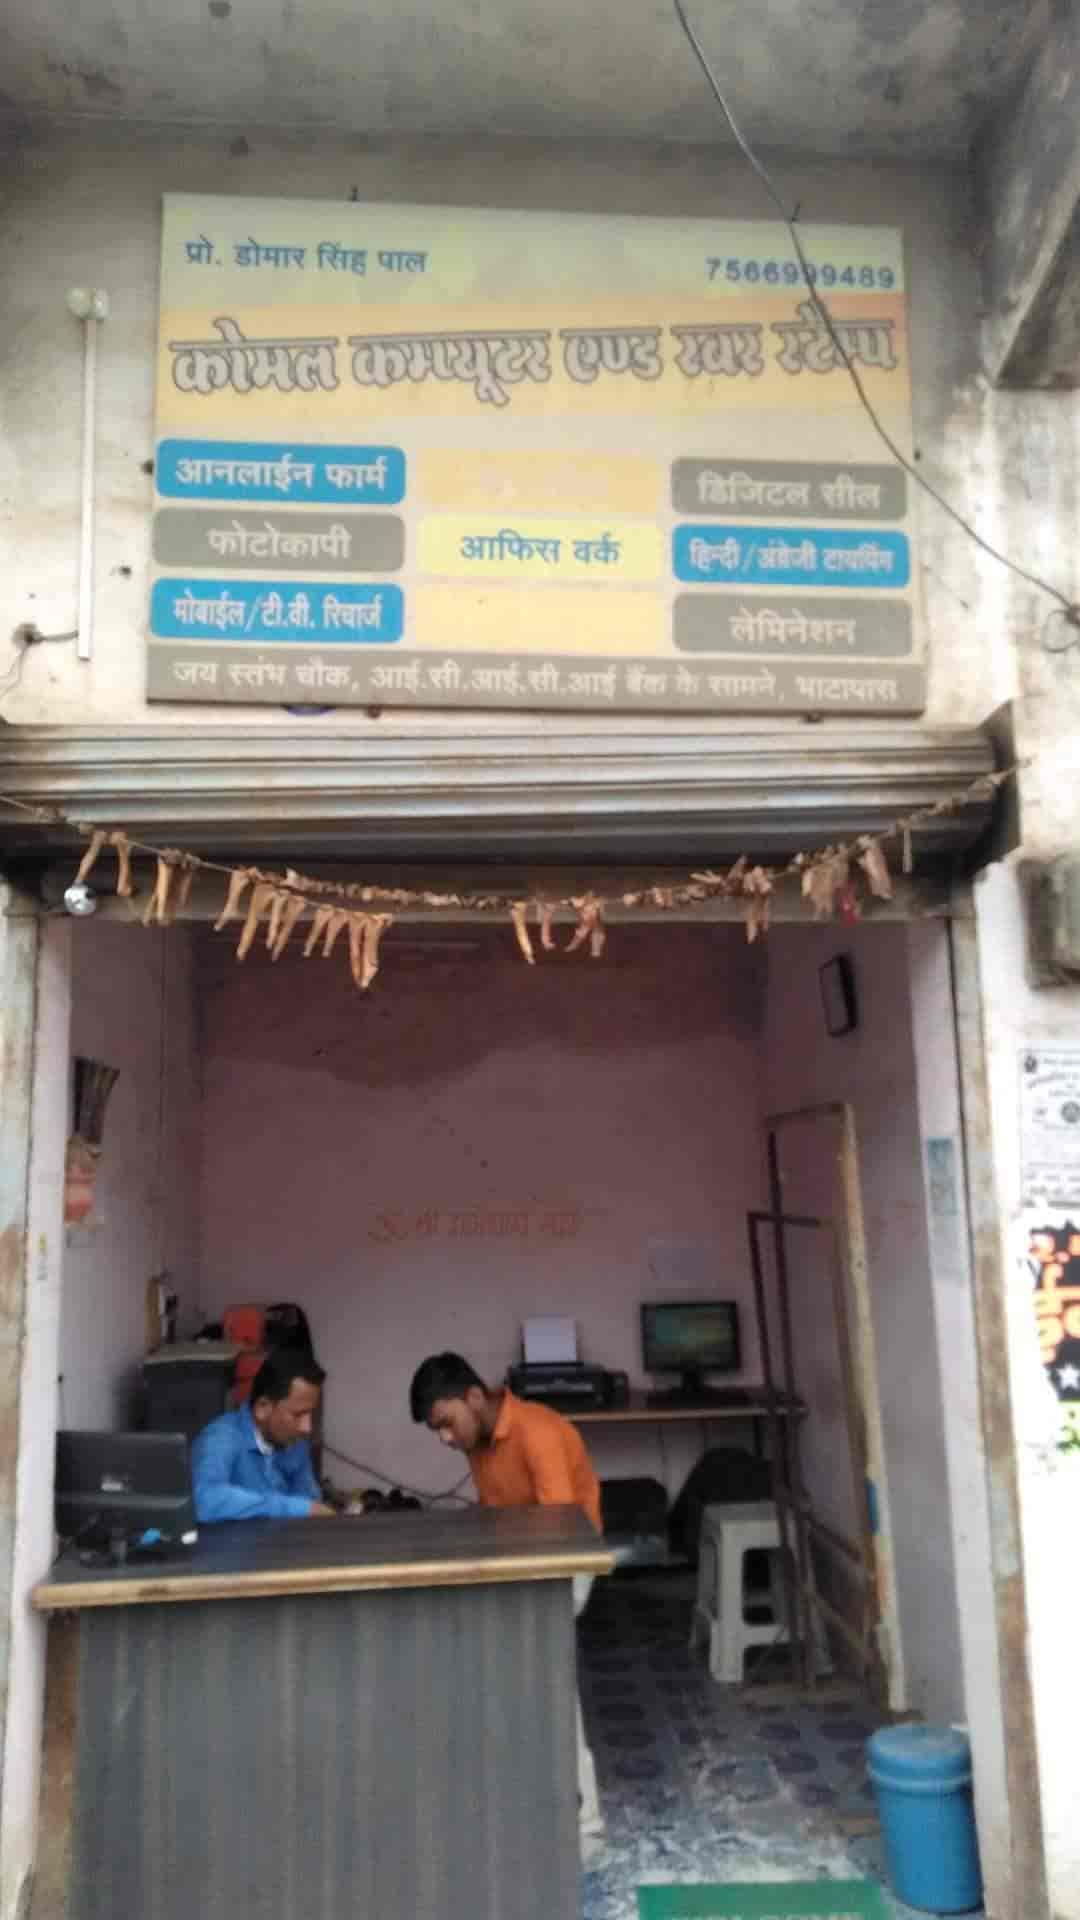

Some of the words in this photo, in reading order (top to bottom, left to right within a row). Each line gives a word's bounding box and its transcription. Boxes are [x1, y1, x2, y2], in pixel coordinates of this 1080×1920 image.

[235, 238, 305, 269] डोमार
[318, 242, 367, 275] सिंह
[378, 250, 427, 273] पाल
[705, 257, 895, 288] 7566999489
[169, 317, 340, 394] कोमल
[559, 326, 664, 384] एण्ड
[175, 455, 314, 491] आनलाईन
[326, 456, 388, 490] फार्म
[697, 470, 810, 507] डिजिटल
[821, 473, 881, 511] सील
[461, 528, 561, 564] आफिस
[573, 532, 621, 564] वर्क
[728, 605, 857, 648] लेमिनेशन
[172, 661, 219, 685] जय
[229, 656, 288, 686] स्तंभ
[675, 664, 699, 696] के
